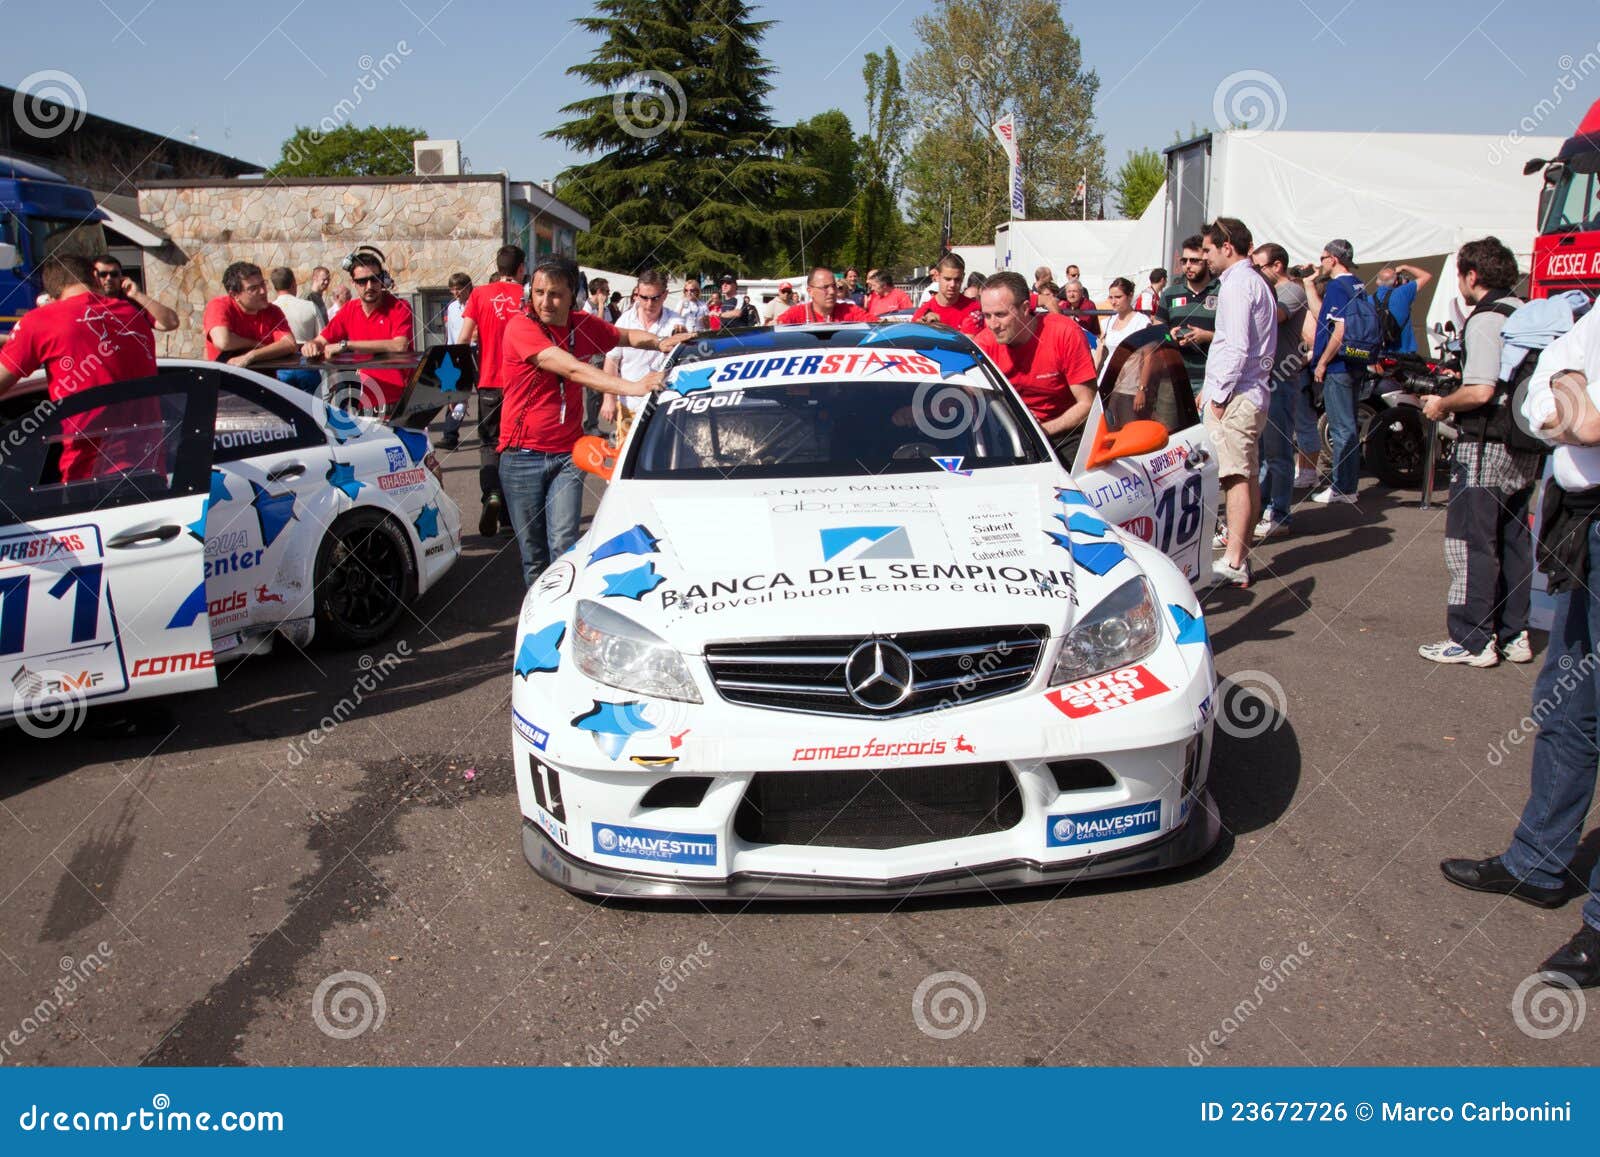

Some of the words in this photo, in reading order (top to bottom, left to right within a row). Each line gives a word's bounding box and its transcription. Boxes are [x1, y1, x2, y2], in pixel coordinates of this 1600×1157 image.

[1547, 253, 1587, 276] KESSEL
[717, 351, 940, 383] SUPERSTARS
[666, 390, 745, 416] Pigoli
[1156, 473, 1202, 554] 18
[661, 572, 795, 611] BANCA
[809, 565, 877, 584] DEL
[888, 563, 1077, 593] SEMPIONE
[784, 586, 850, 600] buon
[860, 582, 940, 593] senso
[974, 582, 996, 594] di
[1006, 584, 1080, 607] banca
[0, 563, 103, 654] 11
[1060, 668, 1139, 701] AUTO
[792, 744, 860, 761] romeo
[862, 737, 947, 757] ferraris
[1076, 810, 1157, 833] MALVESTITI
[618, 834, 711, 856] MALVESTITI
[1077, 830, 1096, 840] CAR
[620, 847, 638, 855] CAR
[639, 849, 673, 859] OUTLET
